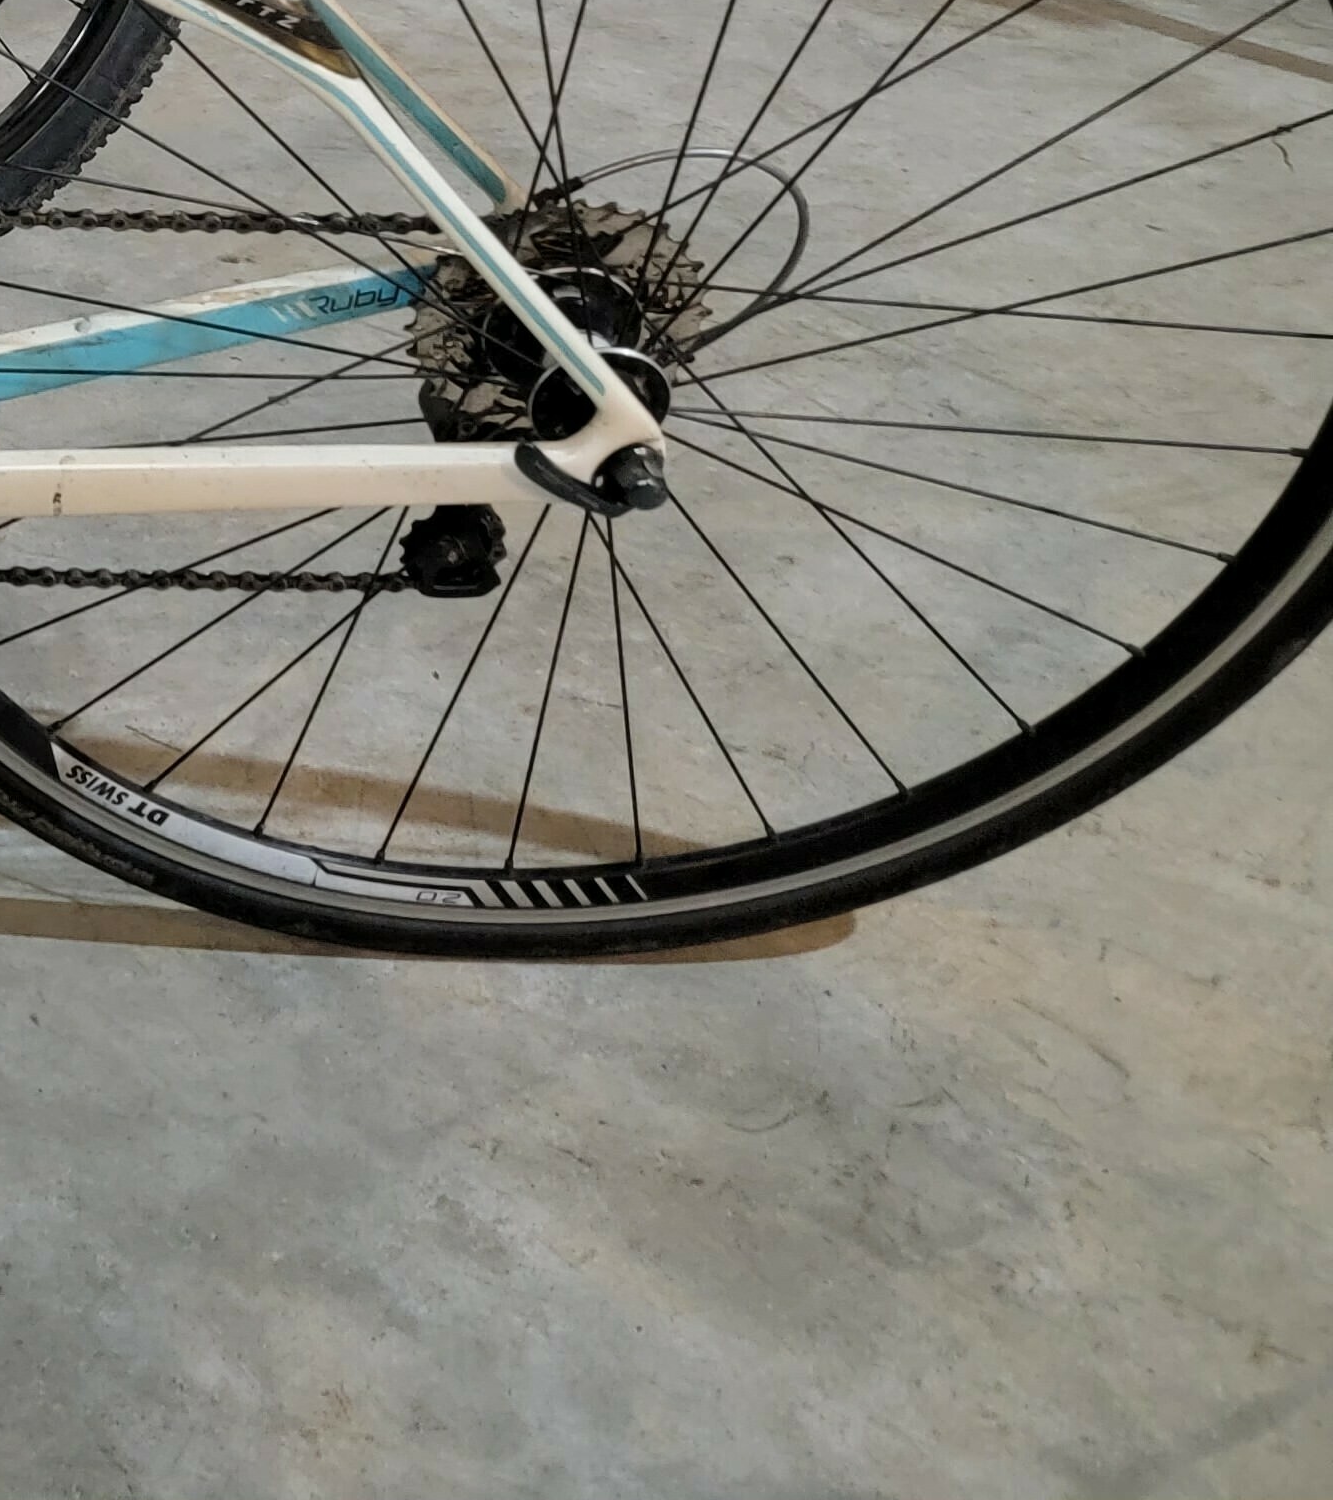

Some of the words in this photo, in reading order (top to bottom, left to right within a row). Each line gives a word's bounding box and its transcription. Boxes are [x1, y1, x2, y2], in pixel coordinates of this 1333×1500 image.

[308, 286, 401, 314] Ruby
[65, 764, 130, 806] SWISS
[127, 800, 171, 827] DT
